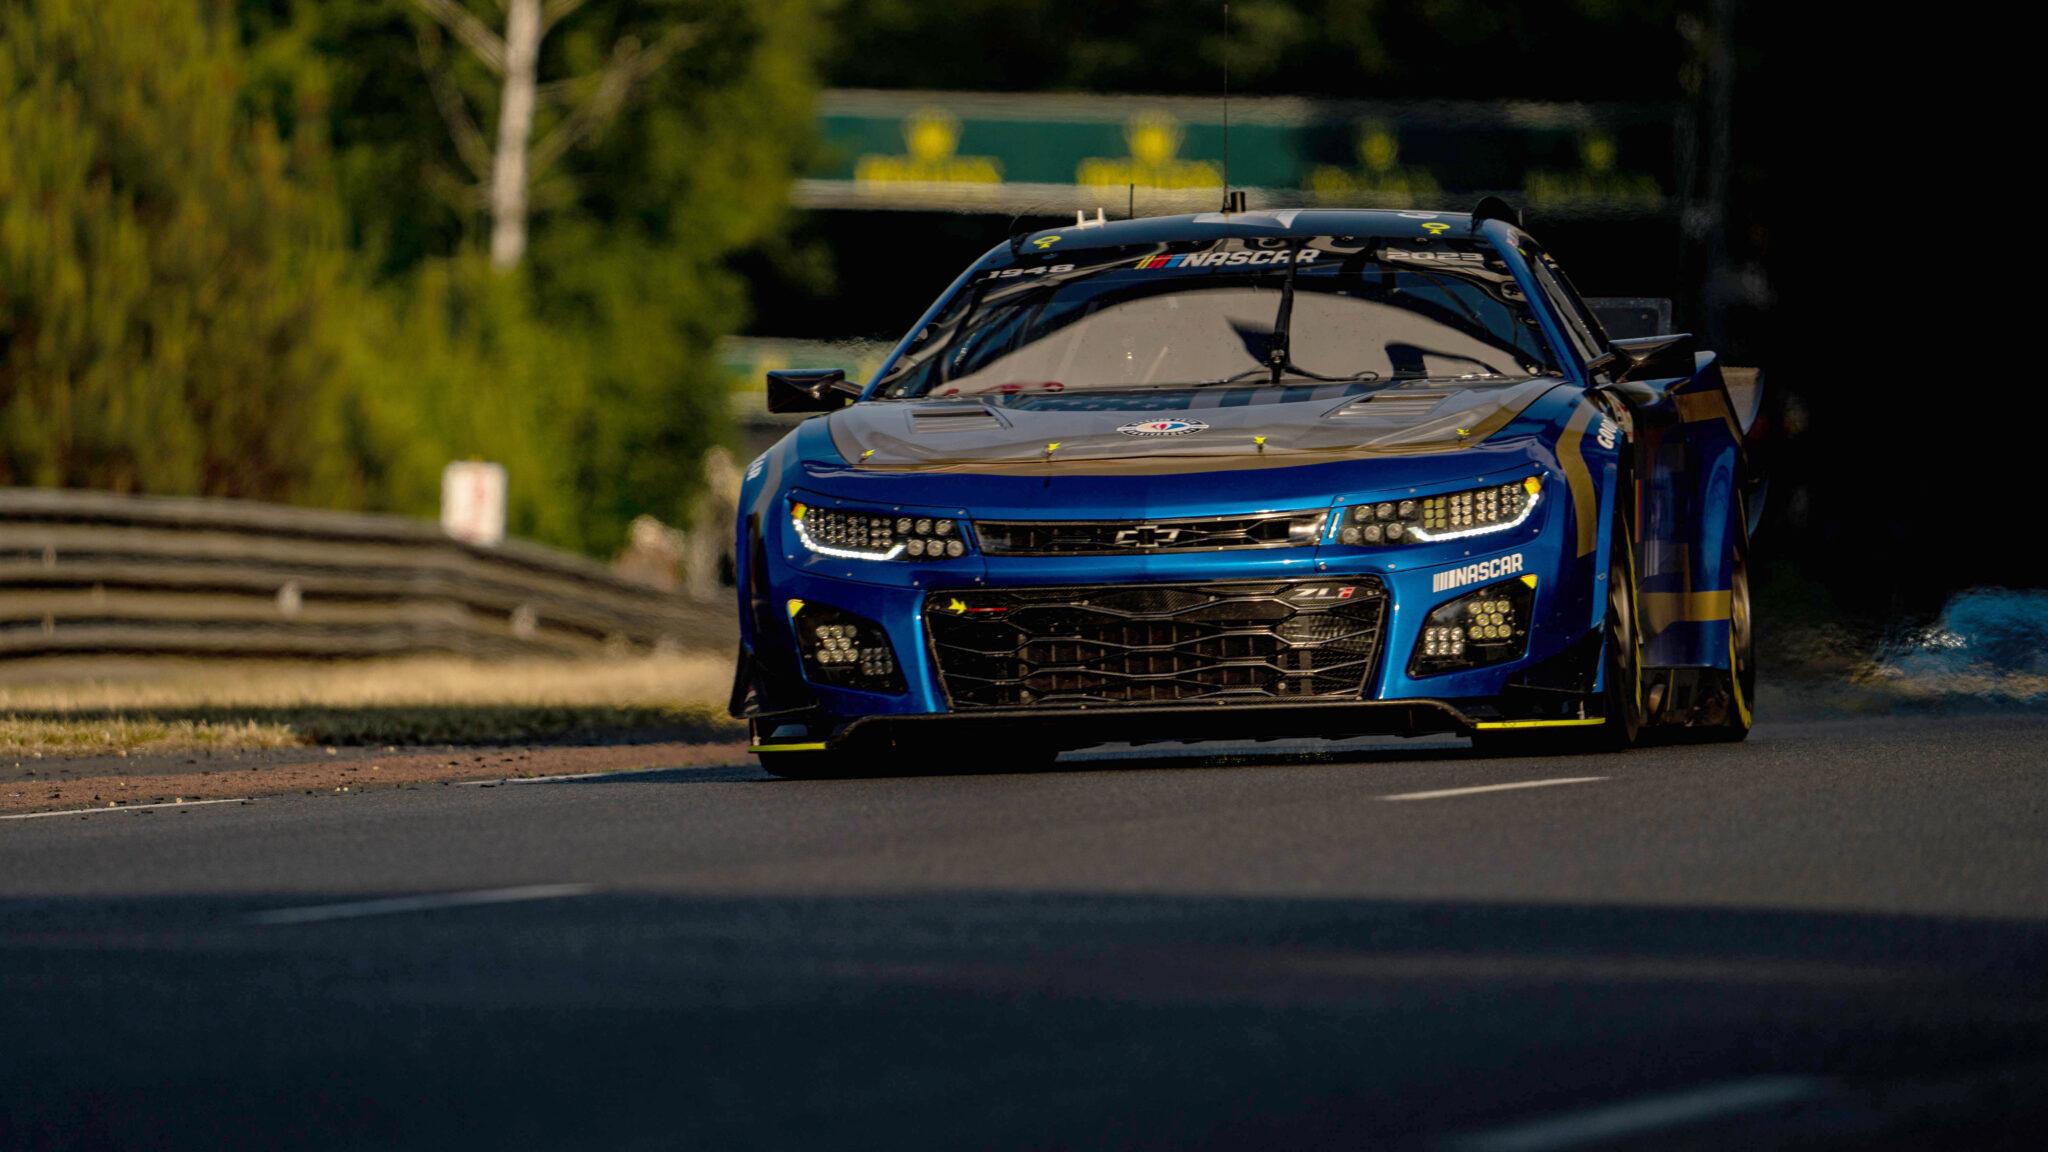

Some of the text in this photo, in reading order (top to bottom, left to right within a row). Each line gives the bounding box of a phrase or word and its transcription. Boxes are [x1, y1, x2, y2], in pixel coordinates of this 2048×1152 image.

[1178, 249, 1321, 268] NASCAR
[1387, 250, 1485, 261] 2023
[987, 263, 1076, 279] 1948
[1455, 552, 1524, 588] NASCAR
[1289, 586, 1356, 600] ZL1
